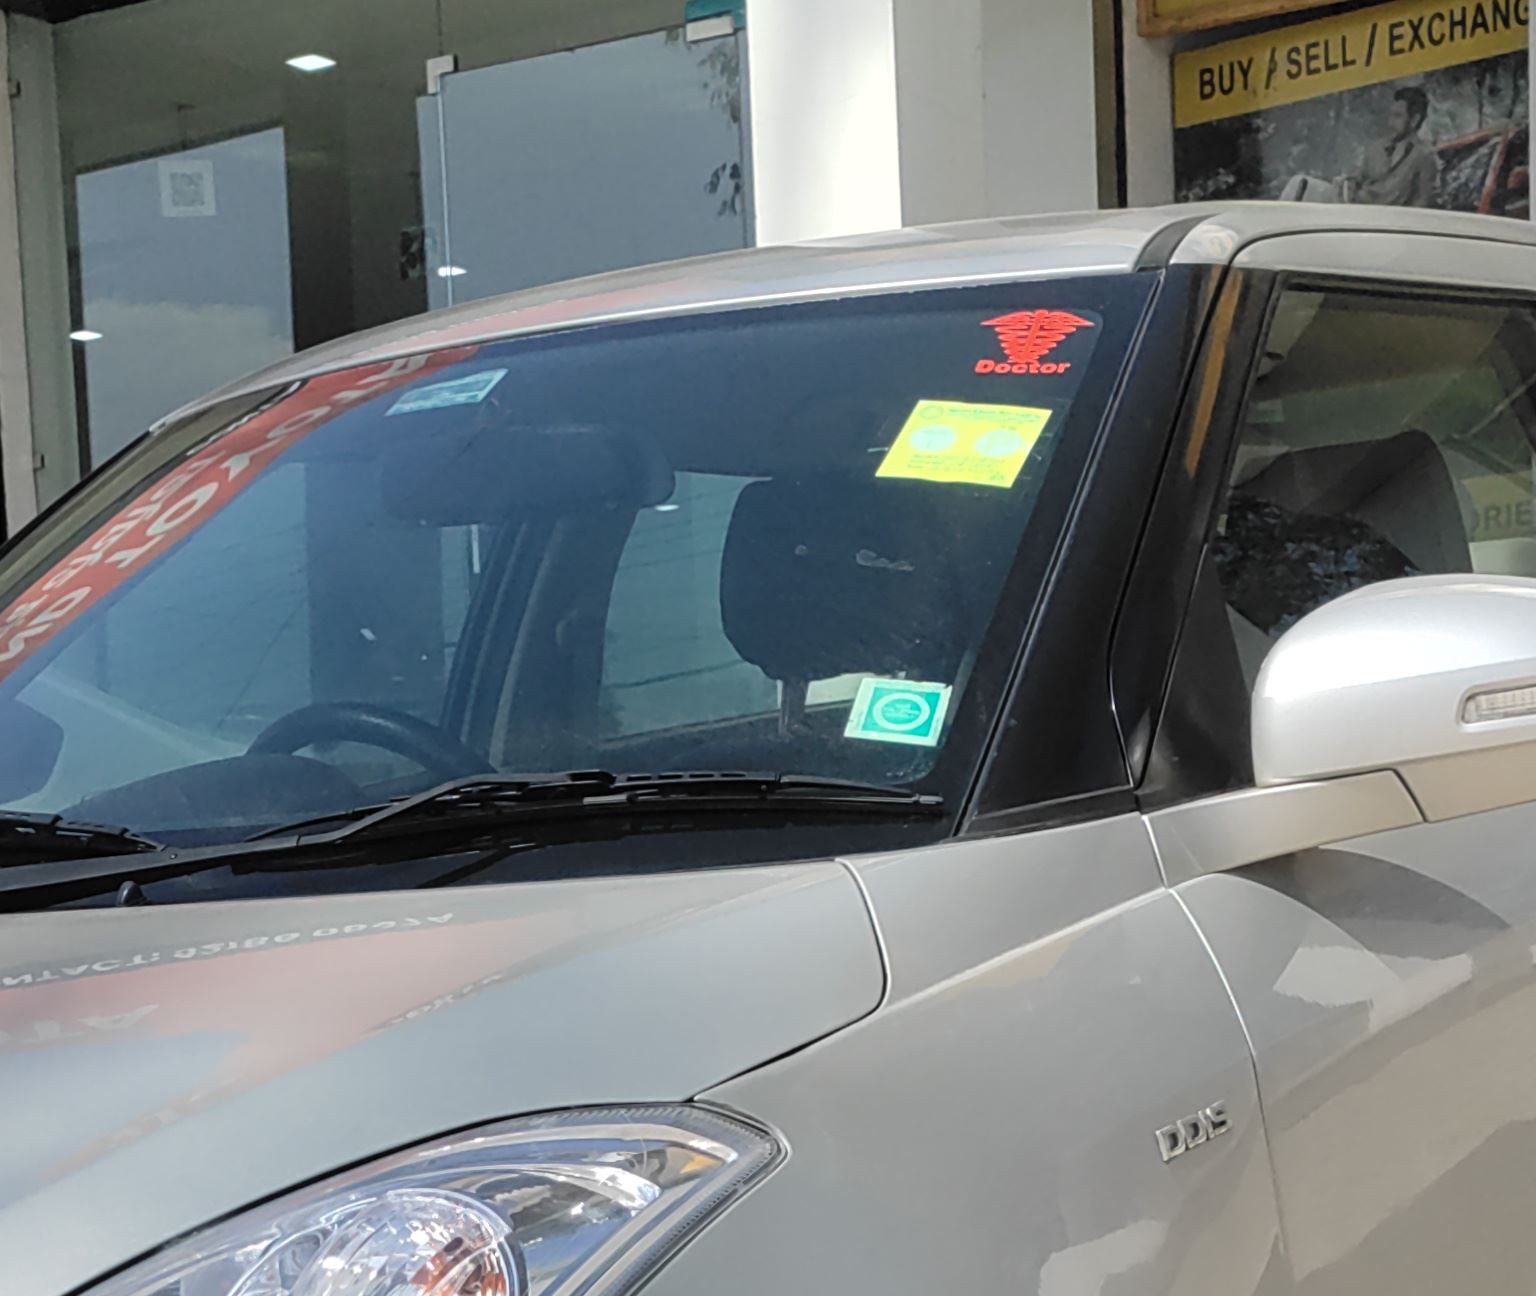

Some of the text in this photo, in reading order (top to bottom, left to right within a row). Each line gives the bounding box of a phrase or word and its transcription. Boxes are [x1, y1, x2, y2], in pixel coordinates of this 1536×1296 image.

[1199, 57, 1254, 100] BUY
[1286, 35, 1356, 80] SELL
[974, 359, 1072, 374] Doctor
